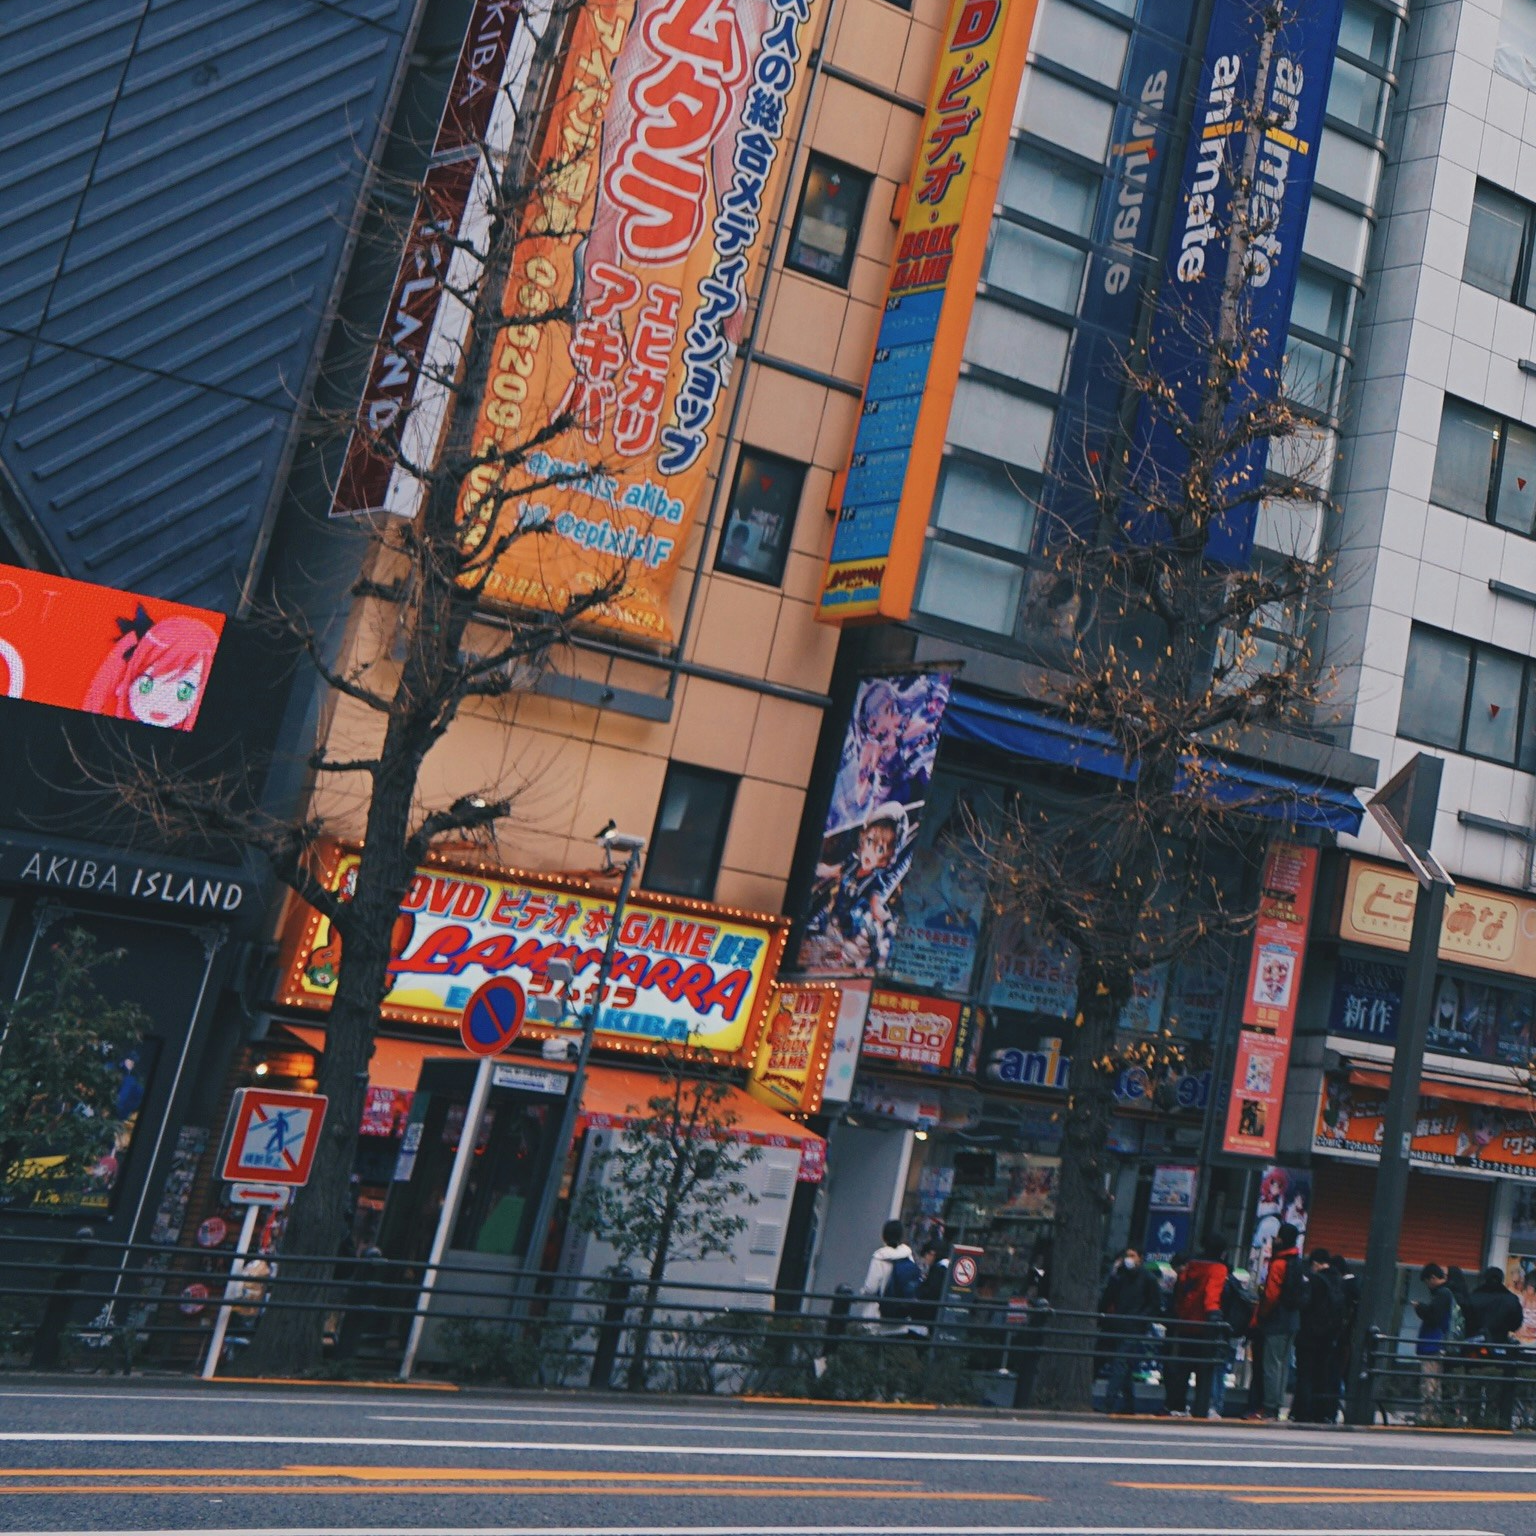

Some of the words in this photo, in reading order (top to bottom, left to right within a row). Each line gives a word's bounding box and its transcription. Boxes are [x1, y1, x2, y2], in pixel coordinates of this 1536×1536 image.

[1176, 54, 1244, 284] animate
[1243, 56, 1309, 288] animate
[898, 224, 959, 261] BOOK
[21, 851, 118, 894] AKIBA
[130, 870, 244, 912] ISLAND
[402, 874, 487, 921] DVD
[489, 889, 580, 934] ビデオ
[582, 906, 613, 941] 本
[619, 913, 717, 958] GAME
[1342, 994, 1393, 1033] 新作
